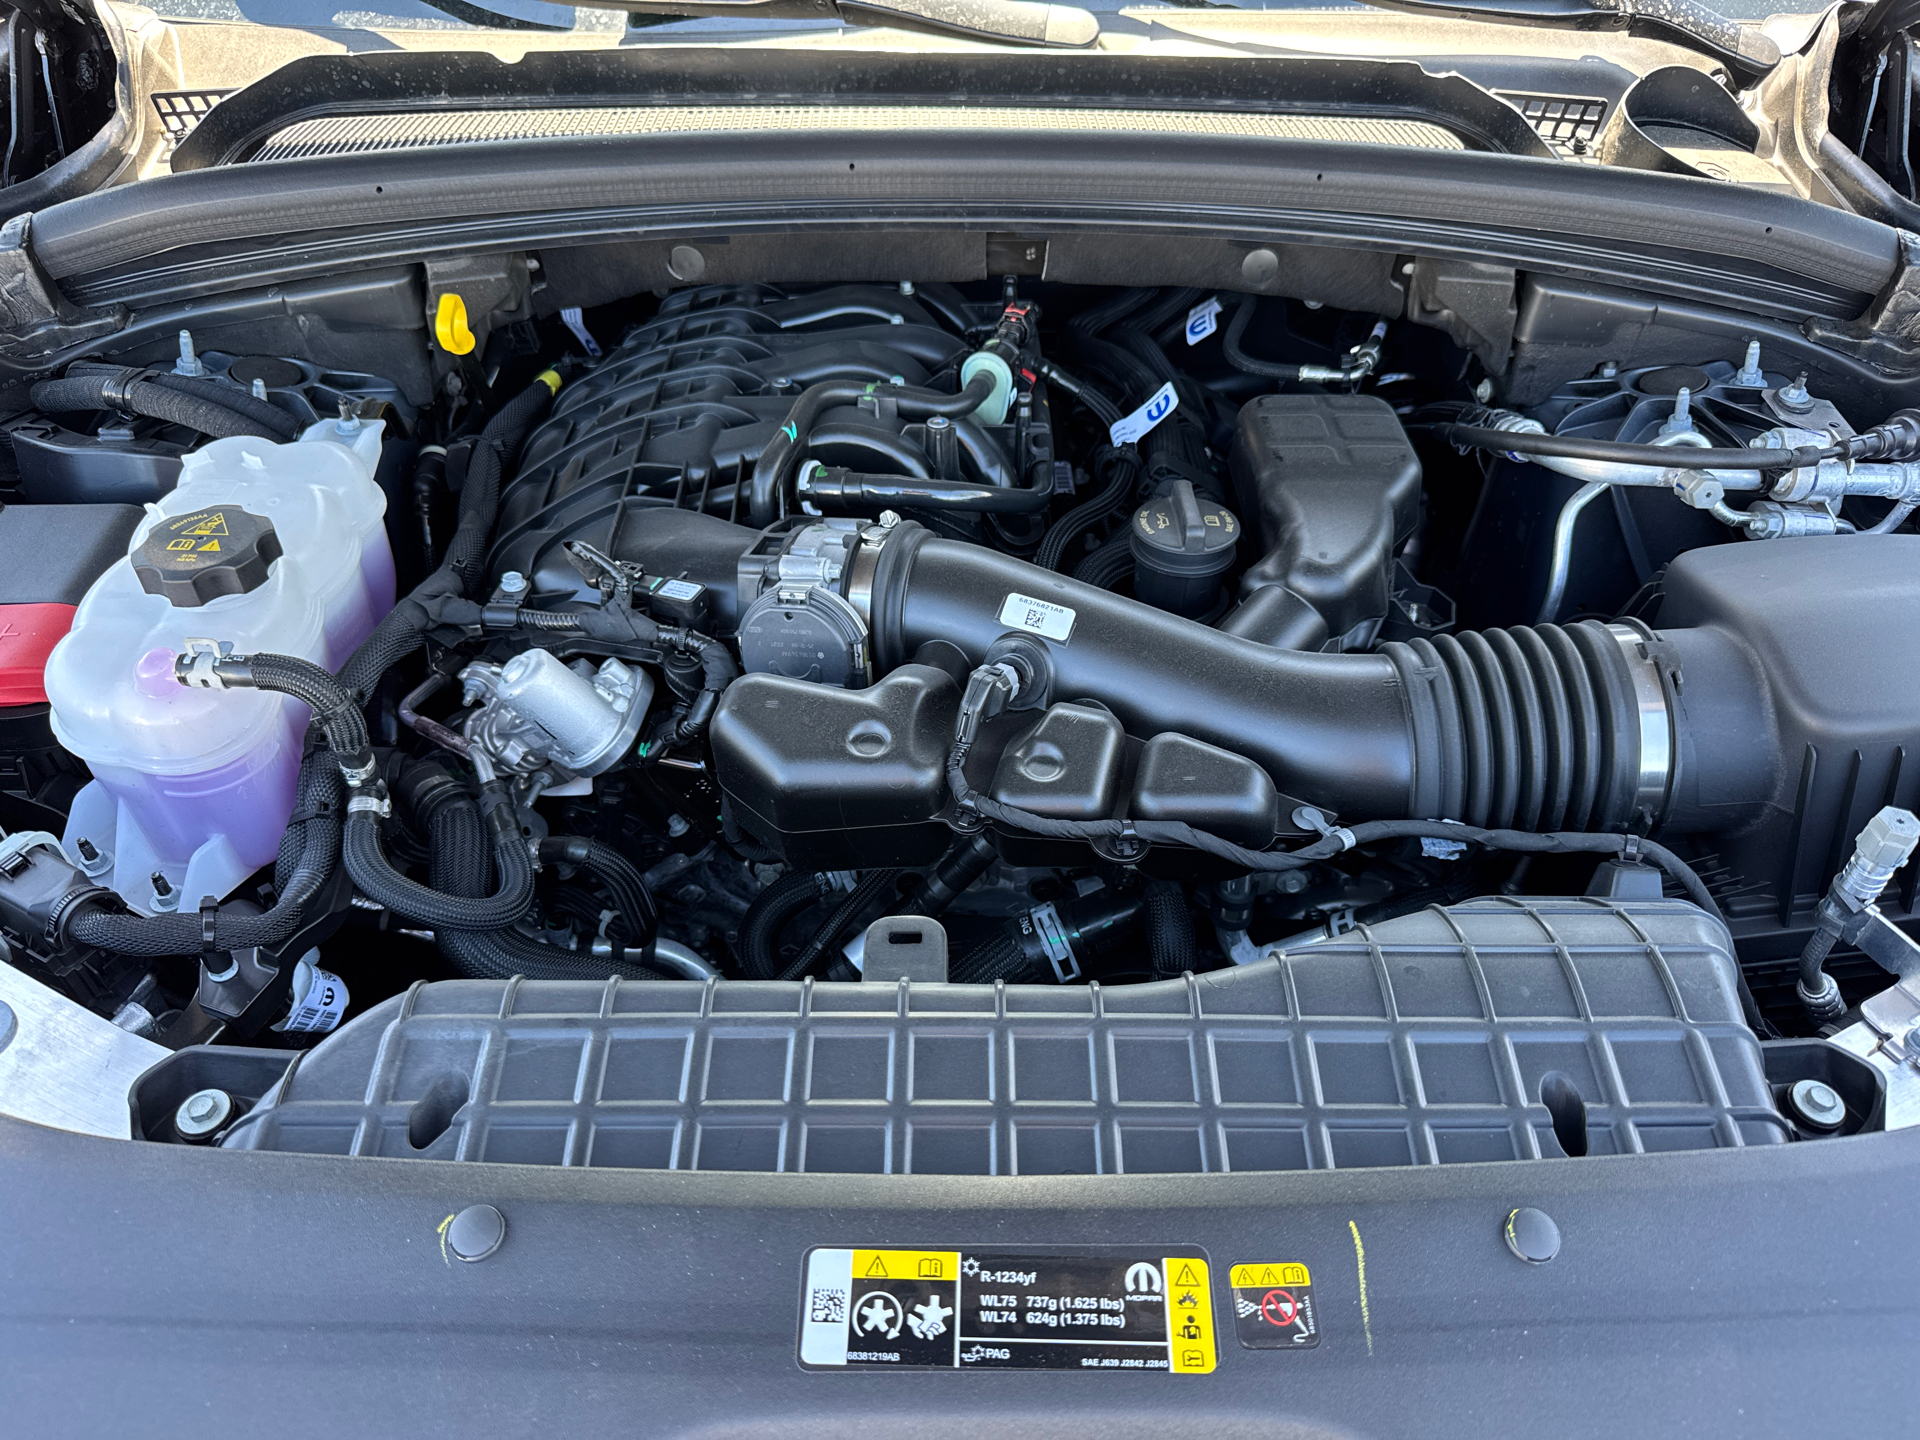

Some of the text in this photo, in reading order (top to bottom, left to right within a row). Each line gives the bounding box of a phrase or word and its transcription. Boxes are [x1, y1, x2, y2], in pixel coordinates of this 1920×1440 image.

[1018, 597, 1064, 614] 68376821AB
[814, 871, 830, 895] ENG
[1018, 916, 1033, 936] ENG
[980, 1270, 1037, 1286] R-1234yf
[980, 1294, 1125, 1312] WL75 737g (1.625 lbs)
[980, 1310, 1126, 1329] WL74 624g (1.375 lbs)
[847, 1351, 901, 1361] 68381219AB
[986, 1348, 1011, 1359] PAG
[1081, 1358, 1169, 1368] SAE J639 J2842 J2845
